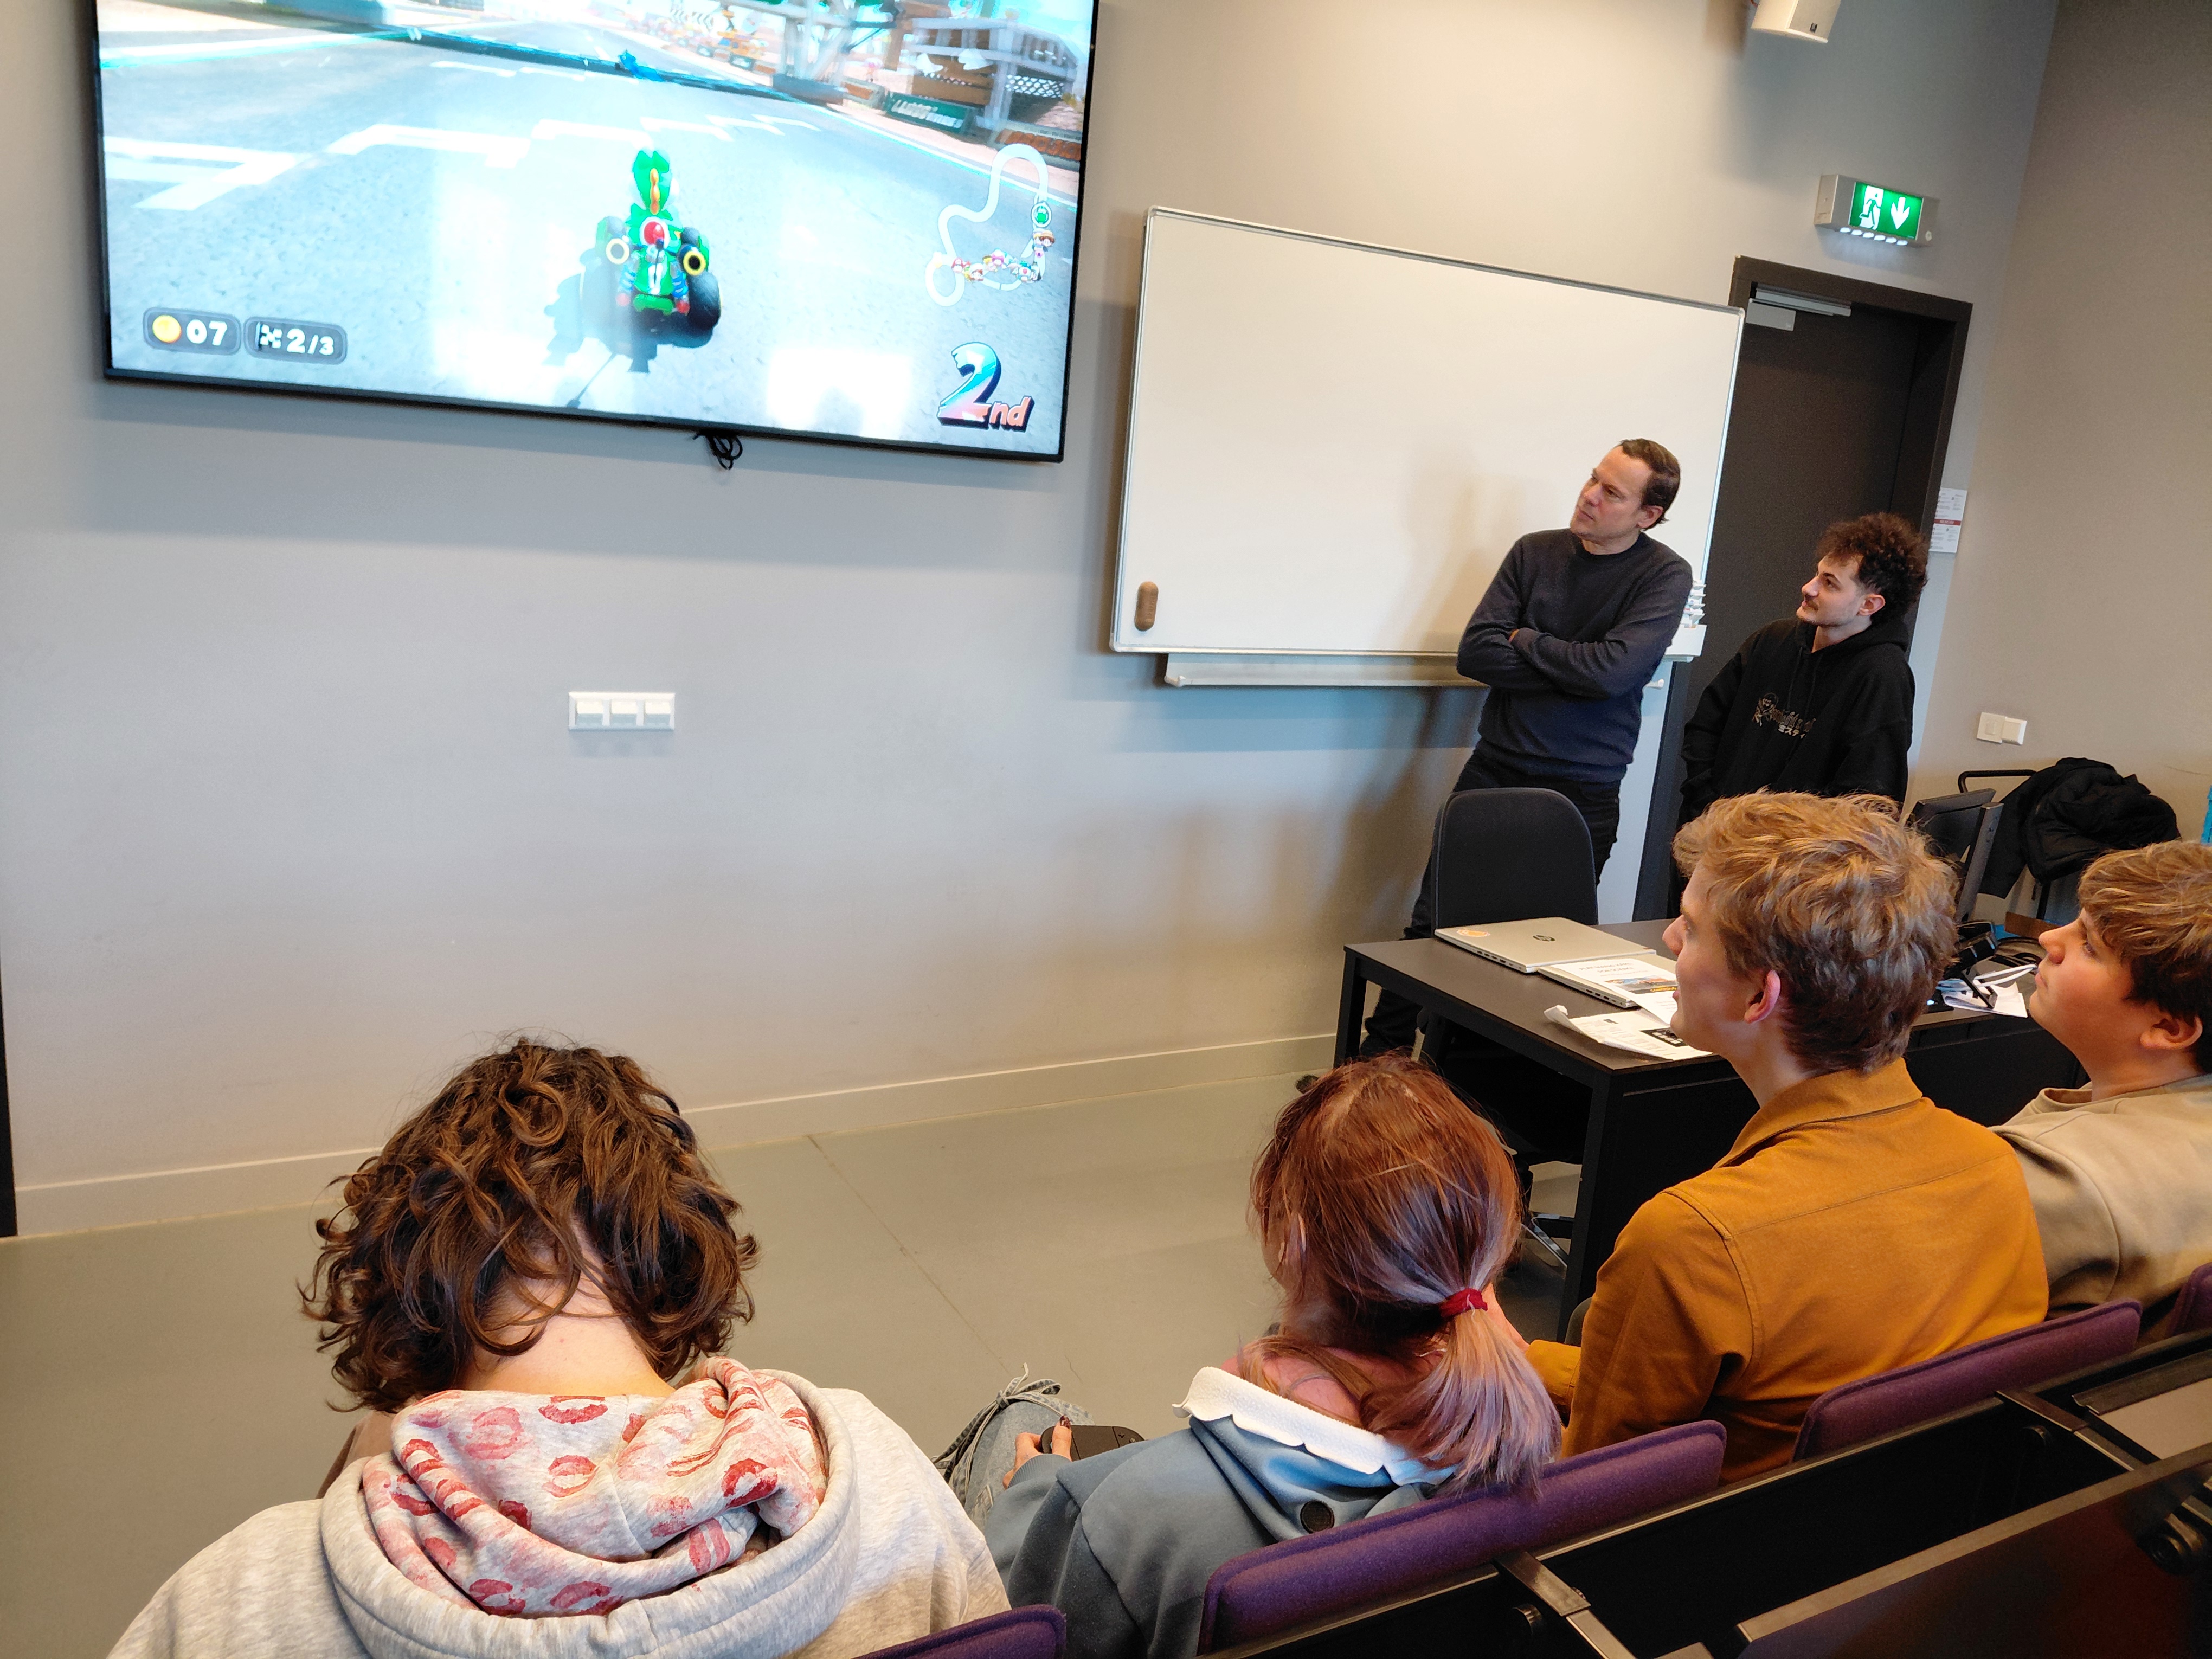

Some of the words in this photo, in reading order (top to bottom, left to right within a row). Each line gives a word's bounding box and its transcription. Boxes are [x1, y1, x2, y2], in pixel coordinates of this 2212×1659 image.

[187, 319, 228, 346] 07
[286, 327, 335, 356] 2/3
[936, 342, 1035, 433] 2nd
